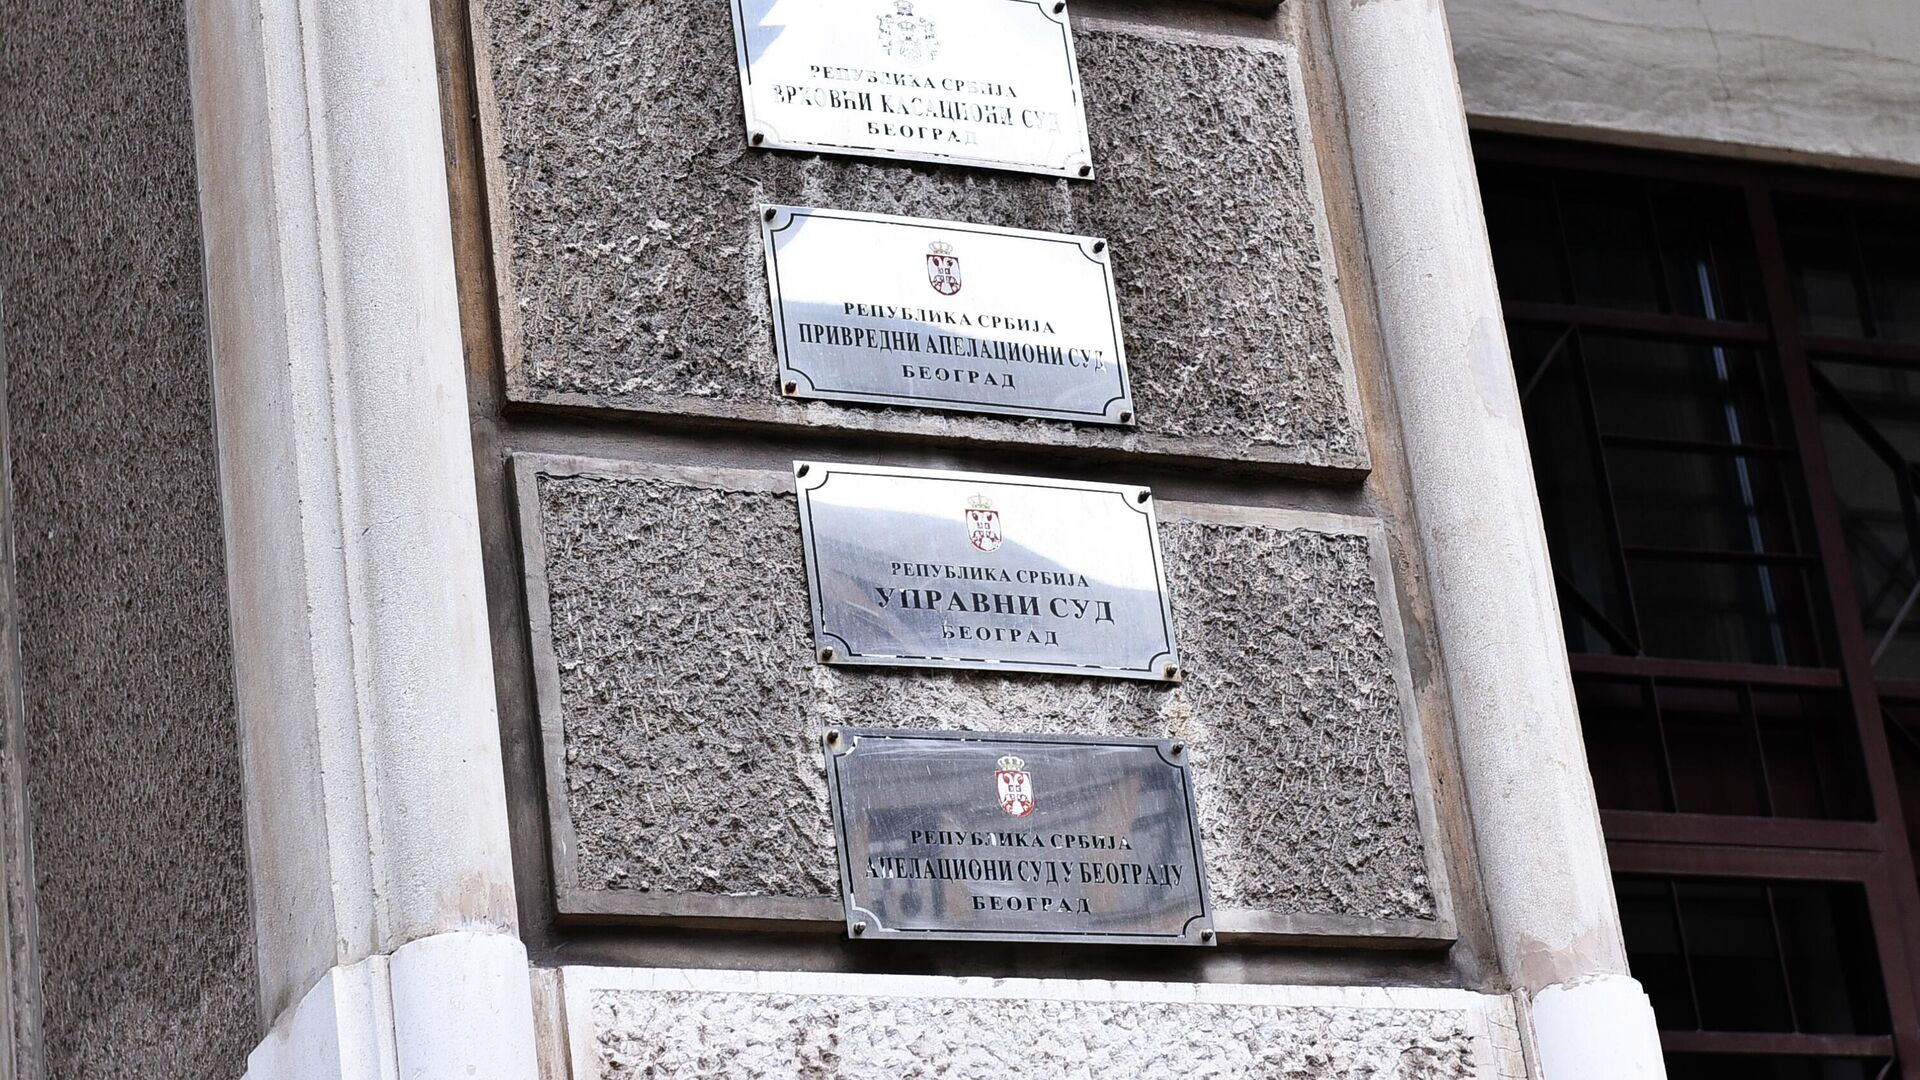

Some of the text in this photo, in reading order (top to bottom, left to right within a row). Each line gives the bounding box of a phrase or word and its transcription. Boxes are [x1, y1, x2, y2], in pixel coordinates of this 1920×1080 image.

[810, 65, 1018, 98] РЕПУБЛИКА СРБИЈА
[880, 94, 1014, 126] КАСАЦИОНИ
[1021, 108, 1062, 134] СУД
[867, 121, 979, 146] БЕОГРАД
[843, 302, 1056, 335] РЕПУБЛИКА СРБИЈА
[799, 322, 1107, 374] ПРИВРЕДНИ АПЕЛАЦИОНИ СУД
[902, 364, 1017, 390] БЕОГРАД
[891, 561, 1090, 588] РЕПУБЛИКА СРБИЈА
[874, 586, 1116, 626] УПРАВНИ СУД
[941, 623, 1060, 647] БЕОГРАД
[911, 830, 1133, 850] РЕПУБЛИКА СРБИЈА
[865, 856, 1014, 884] АПЕЛАЦИОНИ
[1018, 860, 1060, 888] СУД
[1080, 862, 1184, 888] БЕОГРАДУ
[972, 895, 1092, 916] БЕОГРАД
